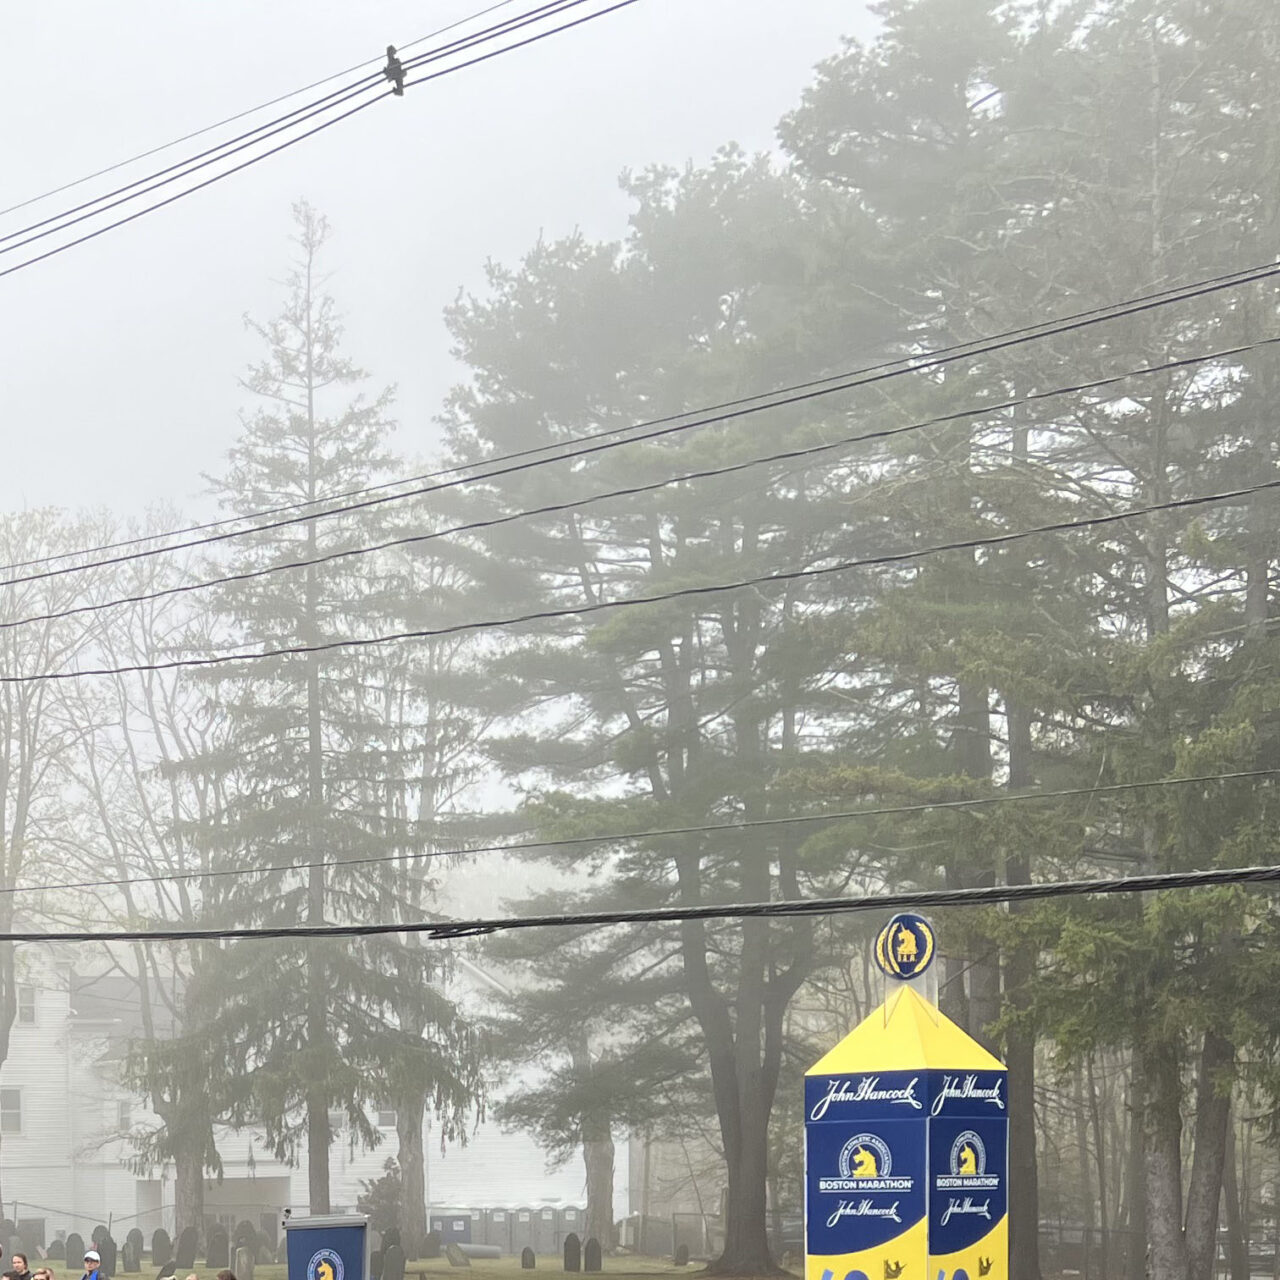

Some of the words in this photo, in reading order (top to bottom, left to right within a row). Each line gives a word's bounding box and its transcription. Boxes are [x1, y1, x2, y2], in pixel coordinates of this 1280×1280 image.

[810, 1079, 857, 1121] John
[856, 1075, 923, 1109] Hancock
[930, 1074, 963, 1117] John
[961, 1074, 1005, 1109] Hancock
[819, 1180, 857, 1190] BOSTON
[858, 1180, 912, 1189] MARATHON
[936, 1178, 963, 1187] BOSTON
[826, 1199, 857, 1227] John
[856, 1198, 902, 1223] Hancock
